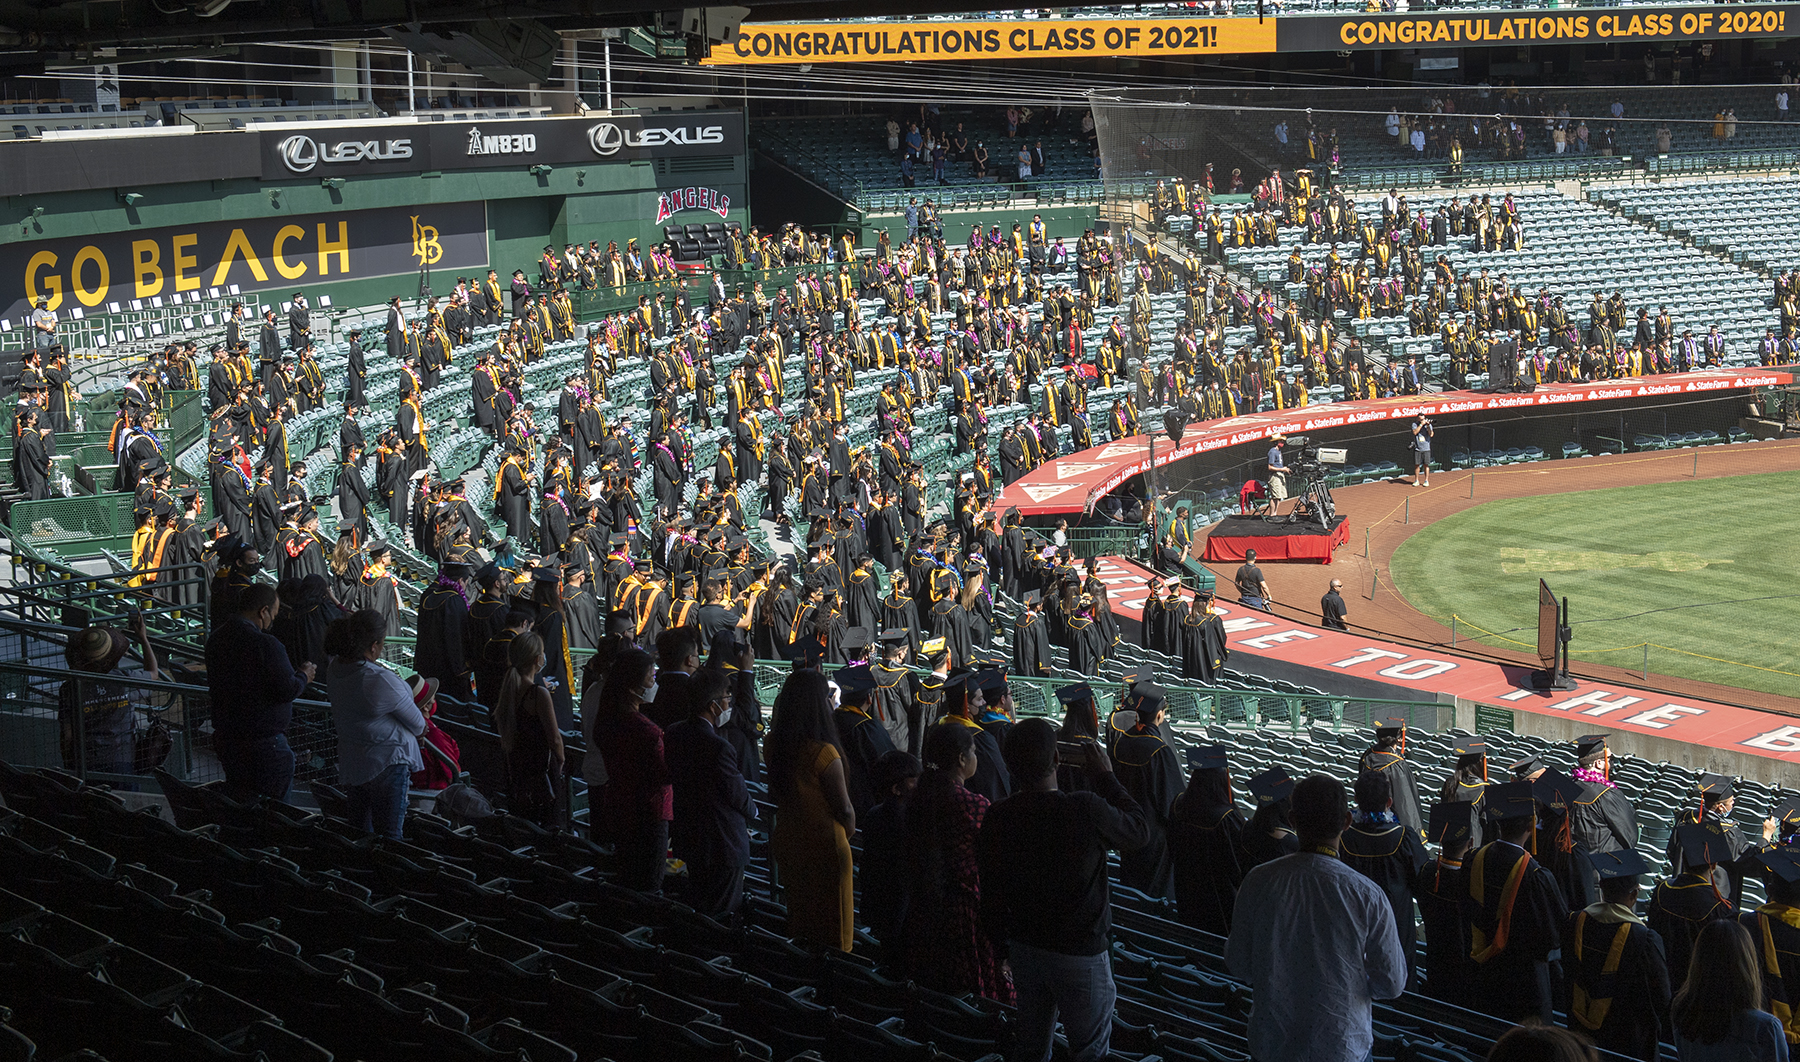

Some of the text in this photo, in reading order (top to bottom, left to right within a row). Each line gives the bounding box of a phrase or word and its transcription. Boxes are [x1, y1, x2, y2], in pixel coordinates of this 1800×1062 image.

[734, 25, 1217, 57] CONGRATULATIONS CLASS OF 2021!
[1340, 10, 1785, 45] CONGRATULATIONS CLASS OF 2020!
[320, 139, 413, 163] LEXUS
[467, 127, 537, 156] AM830
[624, 126, 724, 147] LEXUS
[655, 187, 730, 225] ANGELS
[24, 221, 350, 314] GO BEACH
[1327, 647, 1460, 680] TO
